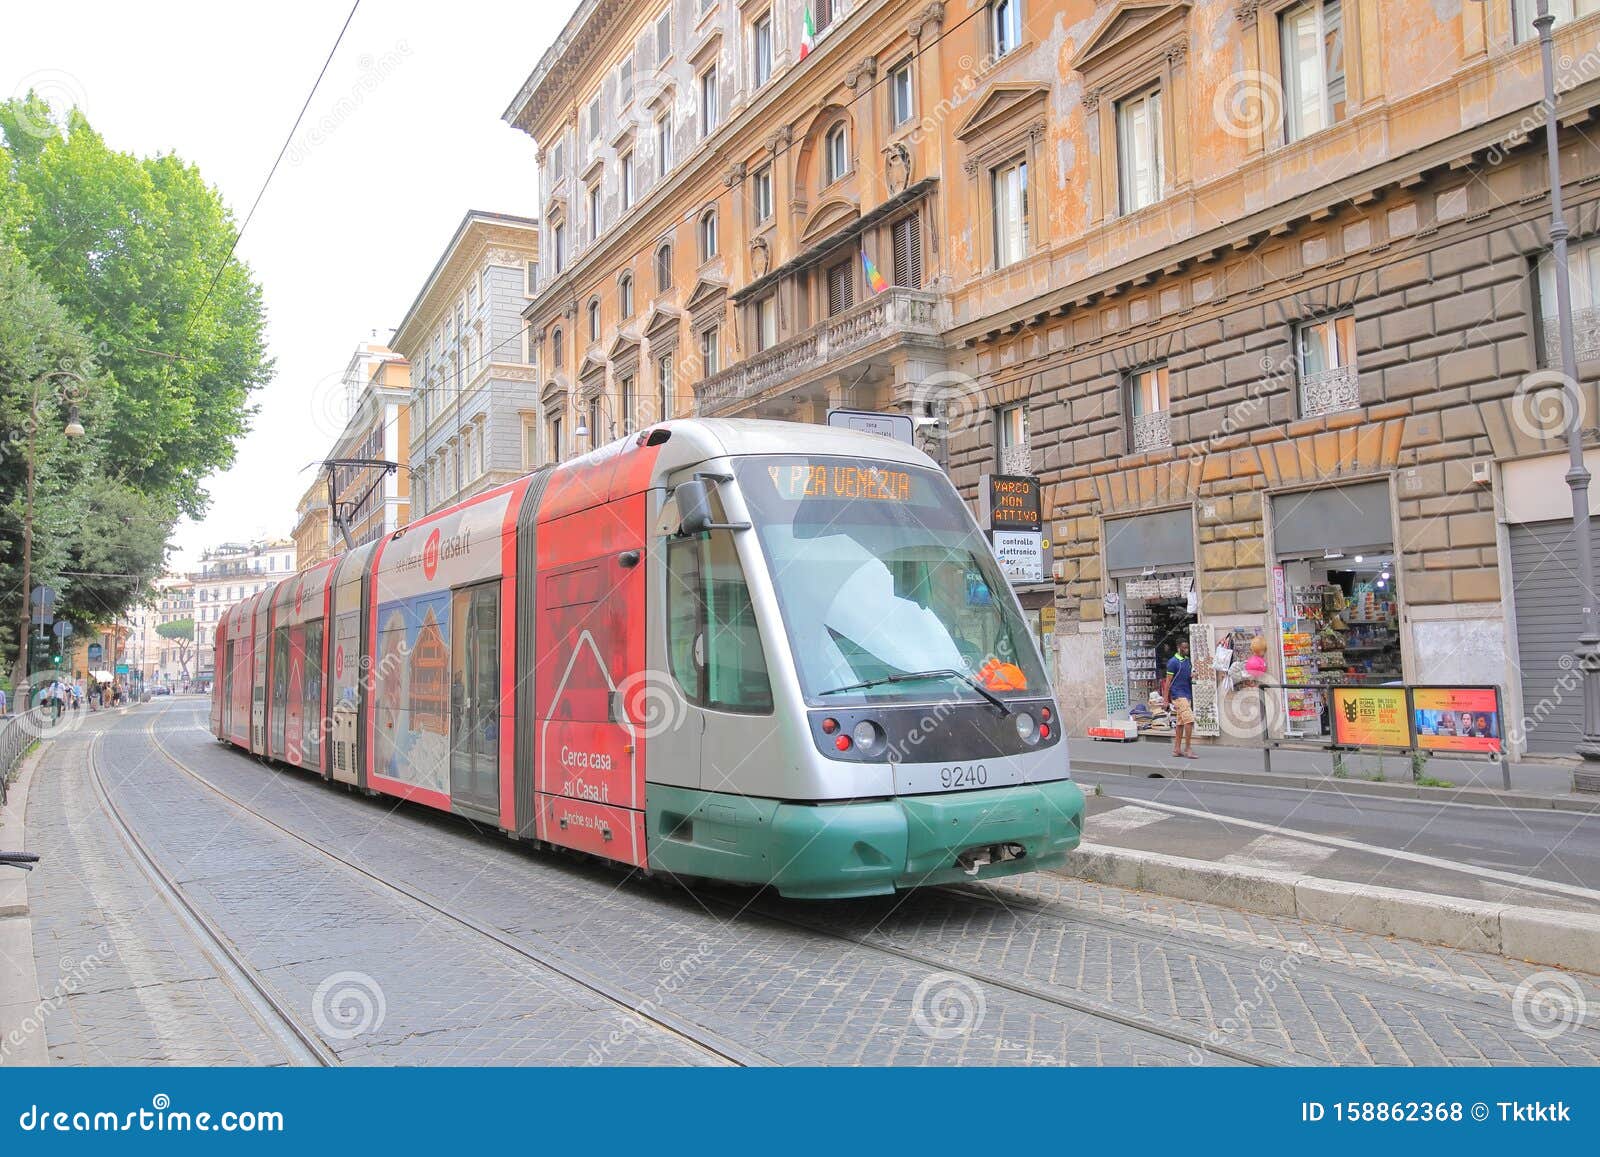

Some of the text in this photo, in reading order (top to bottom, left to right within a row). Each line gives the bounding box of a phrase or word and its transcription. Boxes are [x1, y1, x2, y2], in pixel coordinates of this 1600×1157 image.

[834, 466, 910, 500] VENEZIA
[994, 481, 1030, 494] VARCO
[1001, 496, 1024, 507] NON
[994, 509, 1038, 522] ATTIVO
[441, 526, 471, 560] casa.it
[1002, 538, 1034, 546] controllo
[999, 547, 1037, 556] elettronico
[561, 745, 612, 770] Cerca casa
[941, 764, 987, 788] 9240
[564, 777, 609, 803] su Casa.it
[562, 810, 584, 826] Anche
[585, 815, 593, 827] su
